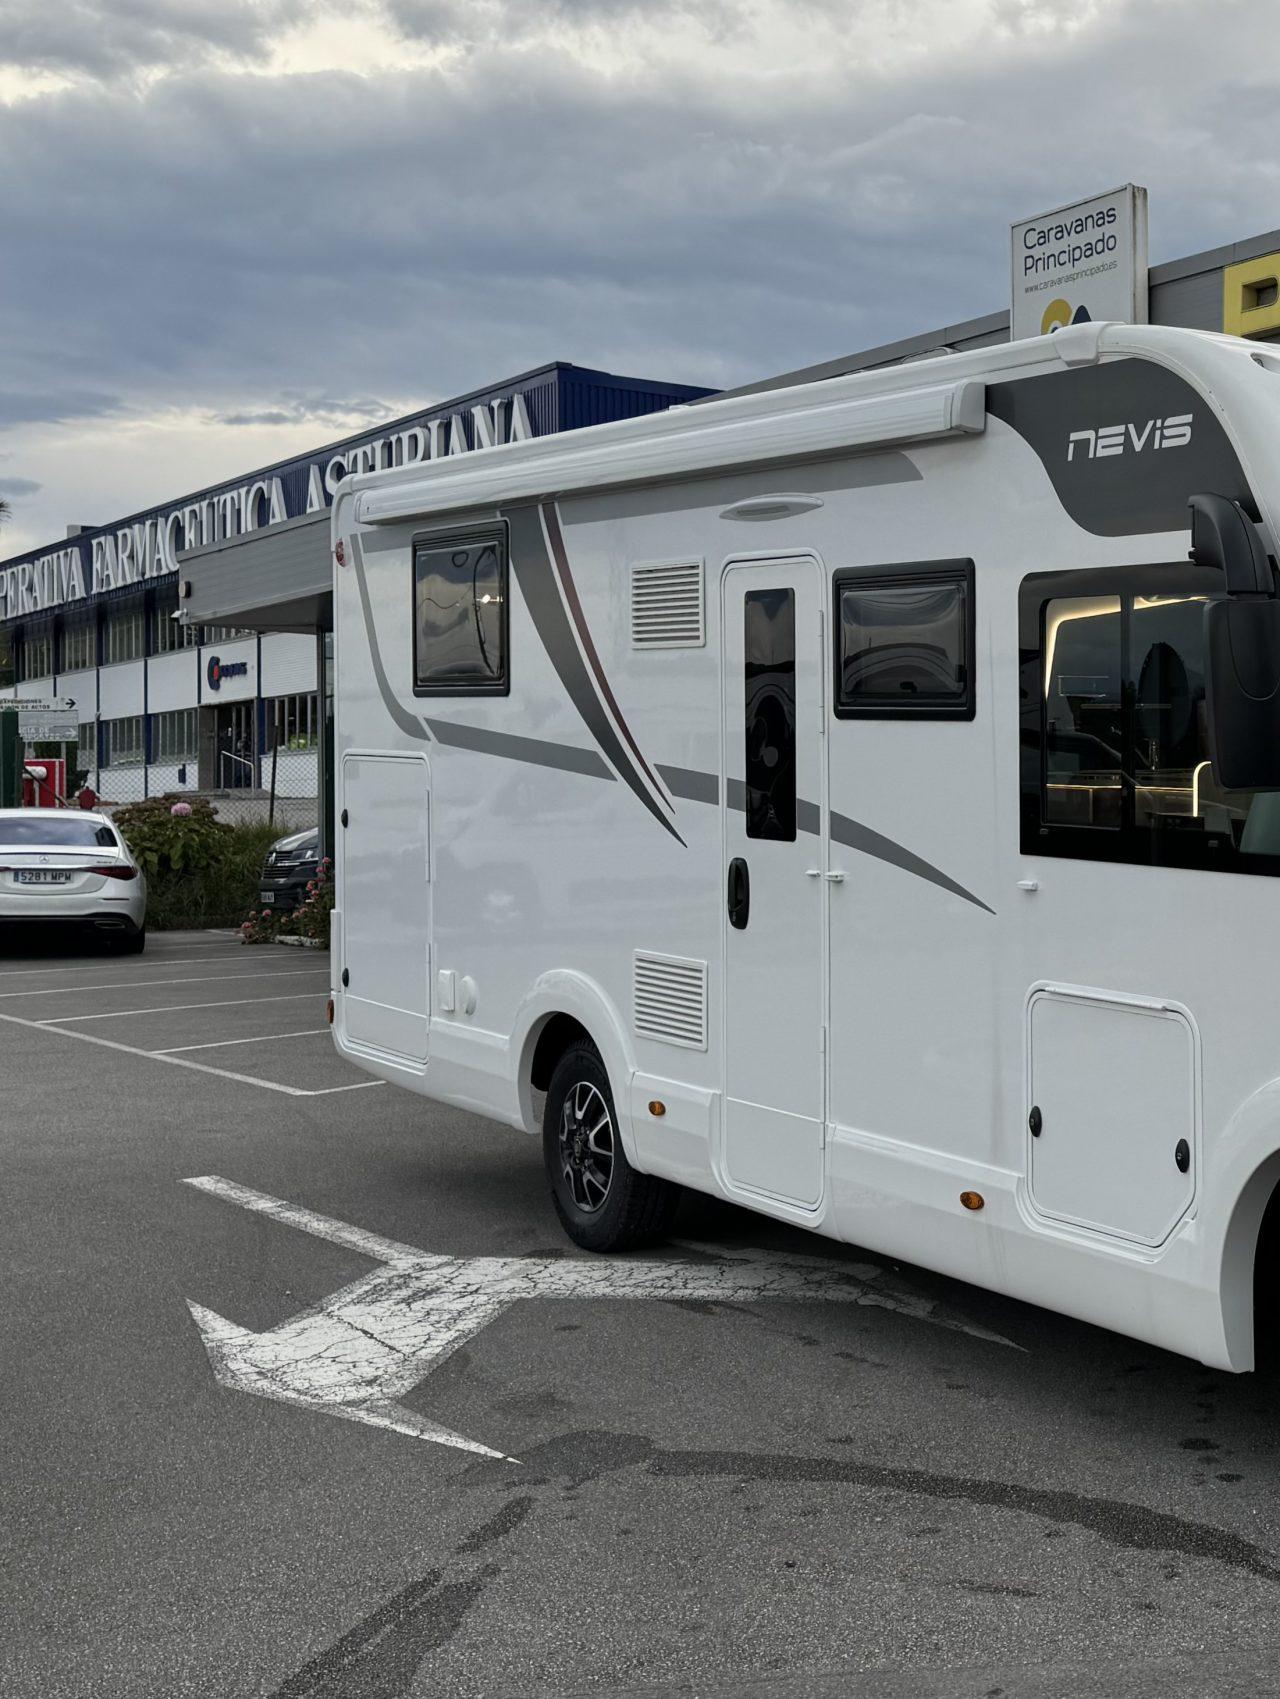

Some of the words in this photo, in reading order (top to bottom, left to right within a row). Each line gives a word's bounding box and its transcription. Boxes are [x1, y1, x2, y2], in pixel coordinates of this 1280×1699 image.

[1023, 207, 1117, 250] Caravanas
[1023, 232, 1117, 277] Principado
[1024, 260, 1118, 294] www.caravanasprincipado.es
[21, 871, 47, 881] 5281
